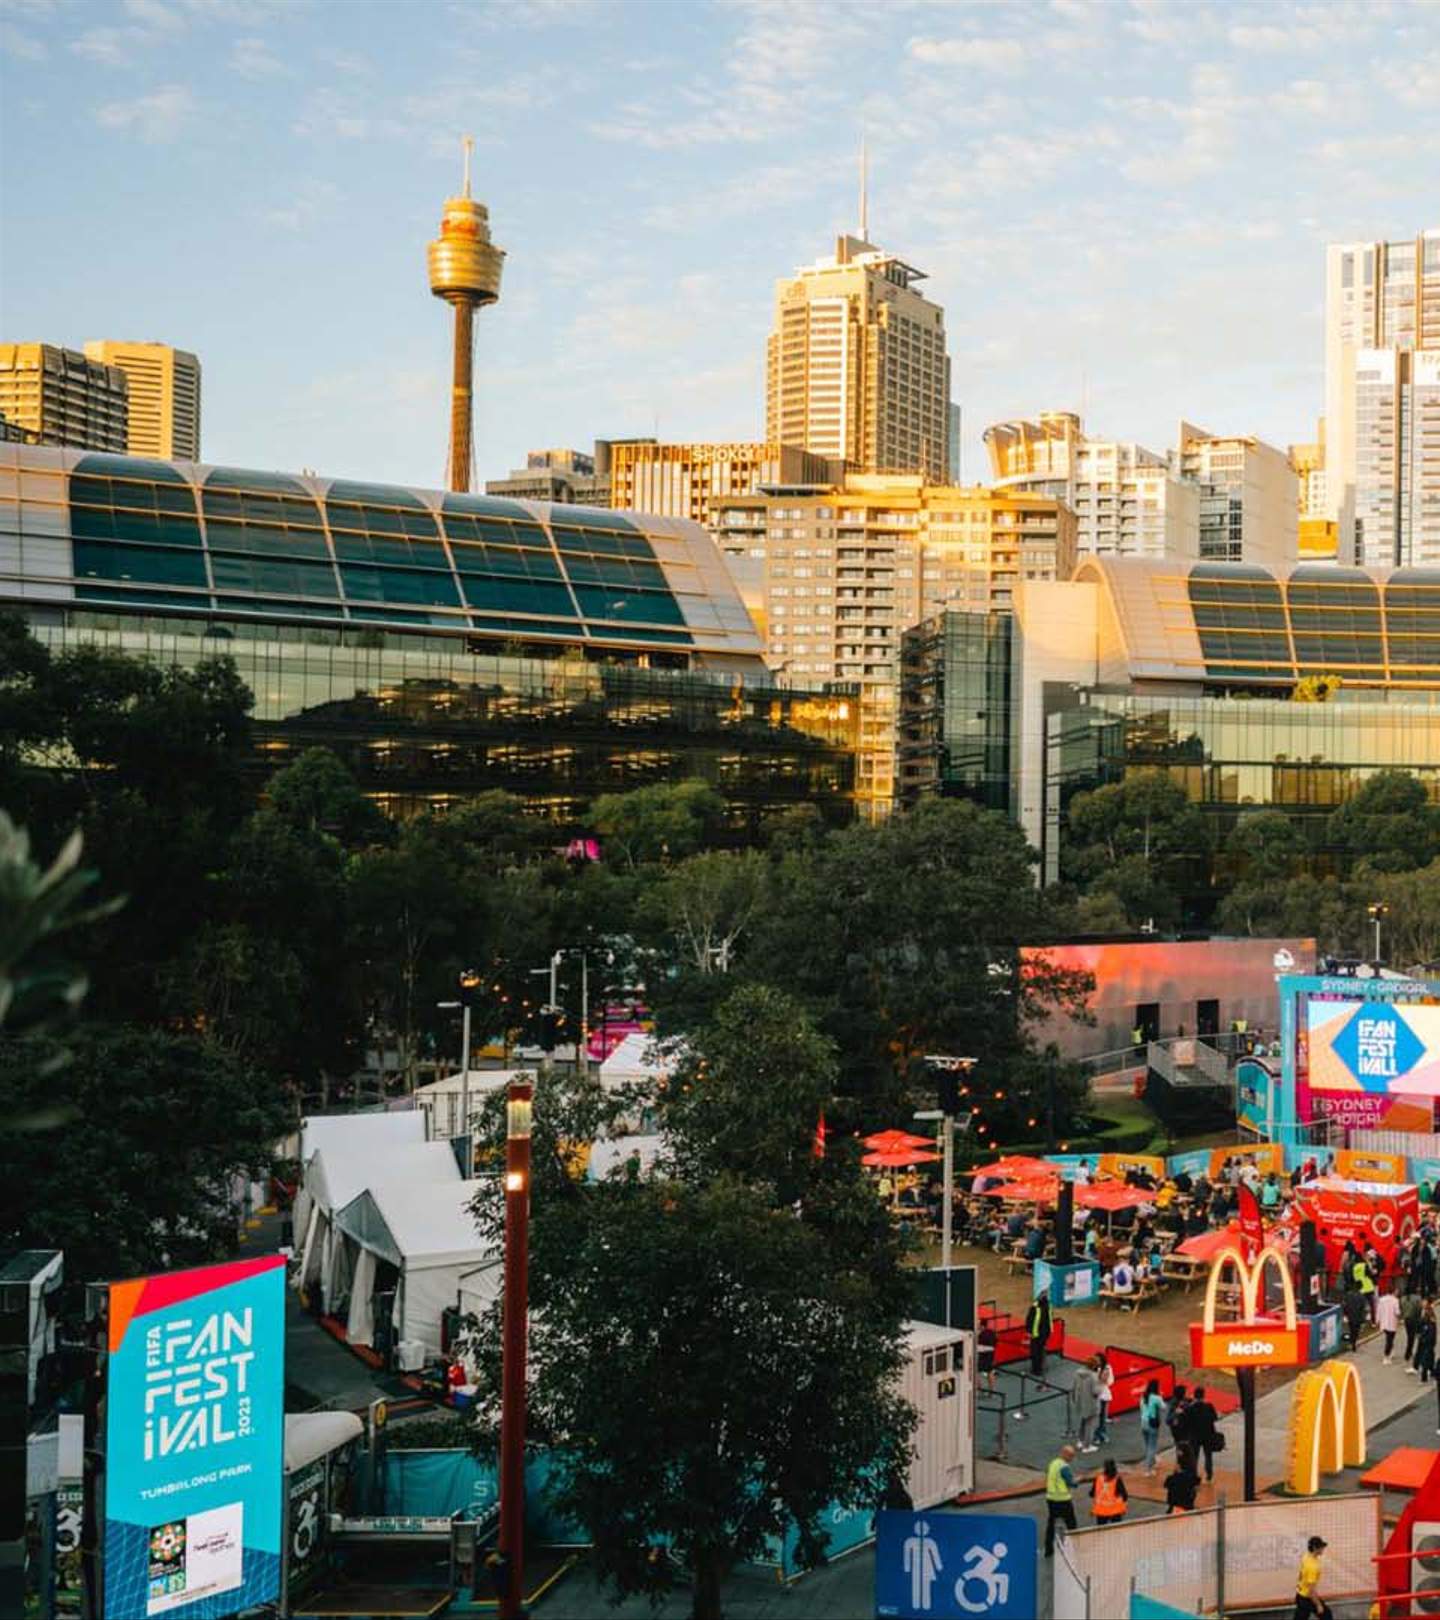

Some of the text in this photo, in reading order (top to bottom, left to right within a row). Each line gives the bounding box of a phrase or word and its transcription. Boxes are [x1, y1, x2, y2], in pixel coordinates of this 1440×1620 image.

[146, 1325, 162, 1368] FIFA
[165, 1307, 253, 1364] FAN
[1228, 1340, 1274, 1356] McDo
[144, 1350, 255, 1414] FEST
[237, 1395, 251, 1438] 2023
[140, 1462, 253, 1500] TUMBALONG PARK
